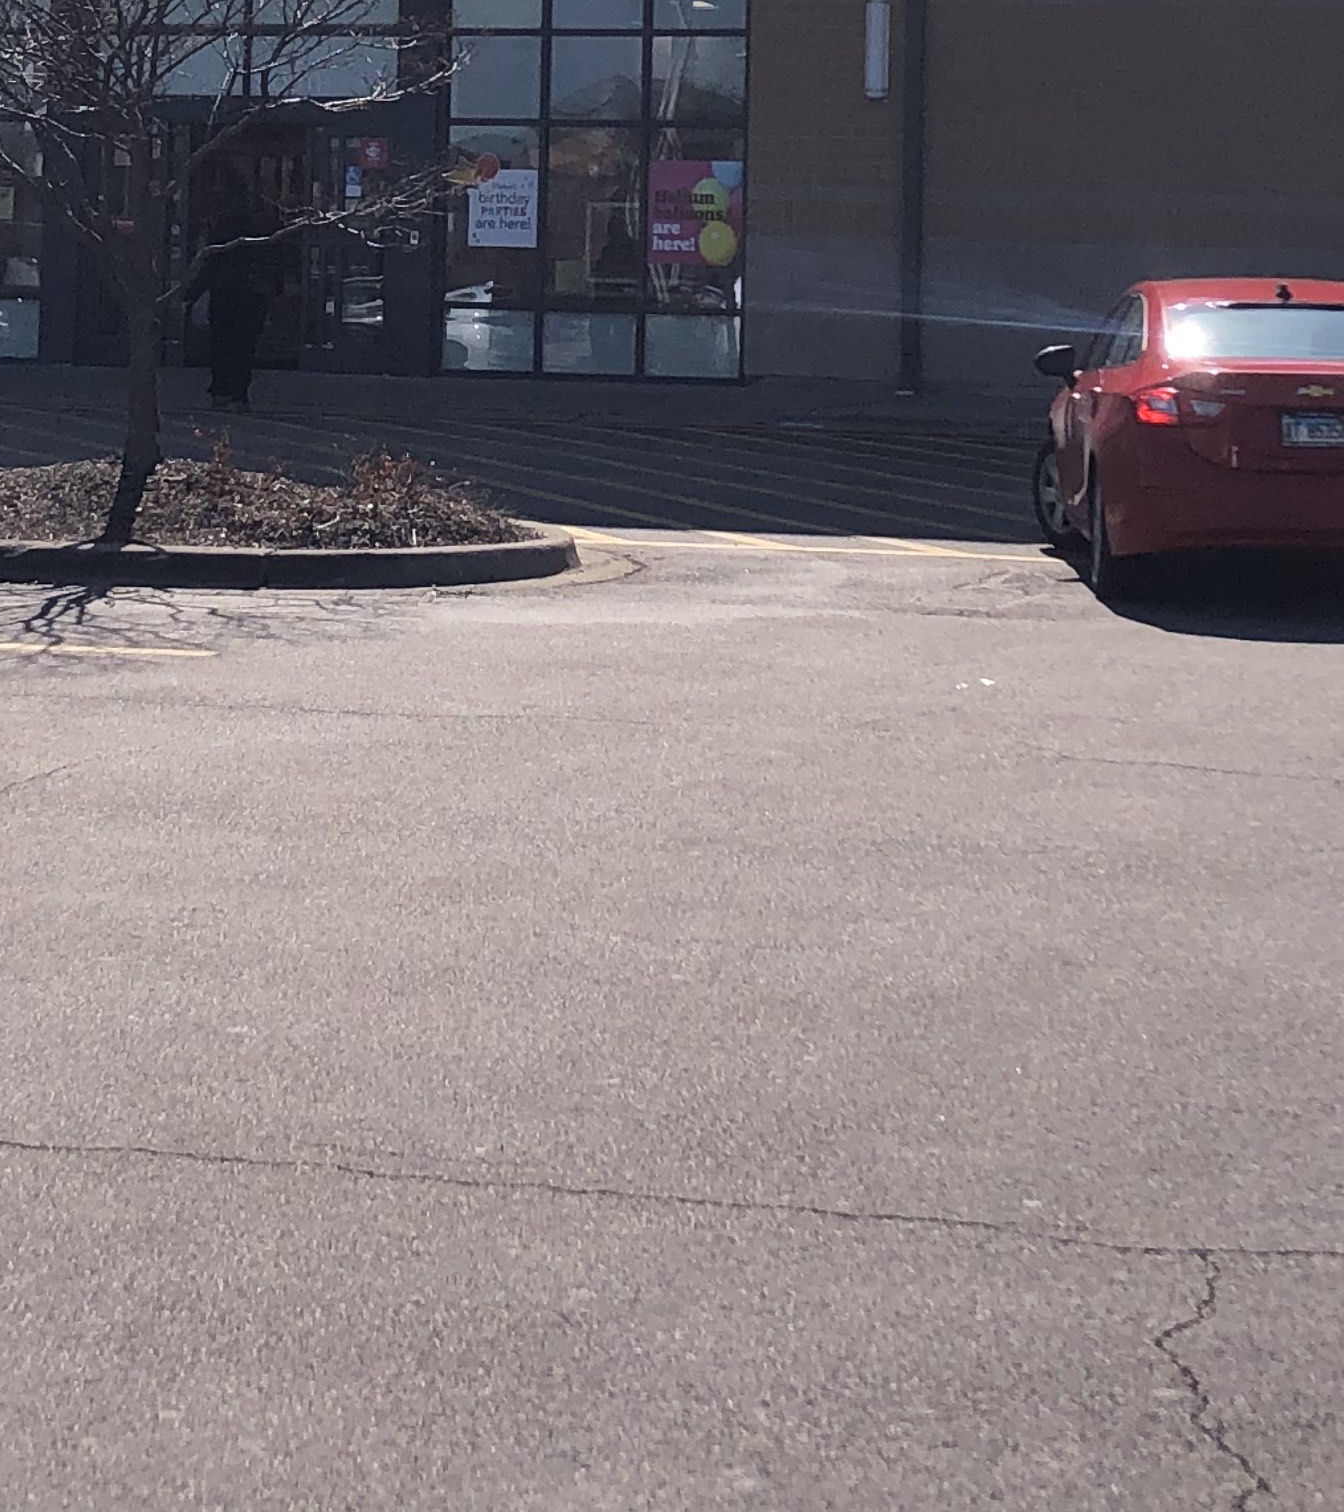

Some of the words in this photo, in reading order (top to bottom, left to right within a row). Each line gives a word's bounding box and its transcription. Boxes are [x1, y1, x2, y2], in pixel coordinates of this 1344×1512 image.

[478, 191, 530, 206] birthday
[476, 219, 495, 229] are
[499, 216, 531, 230] here!
[652, 223, 681, 235] are
[651, 235, 695, 252] here!
